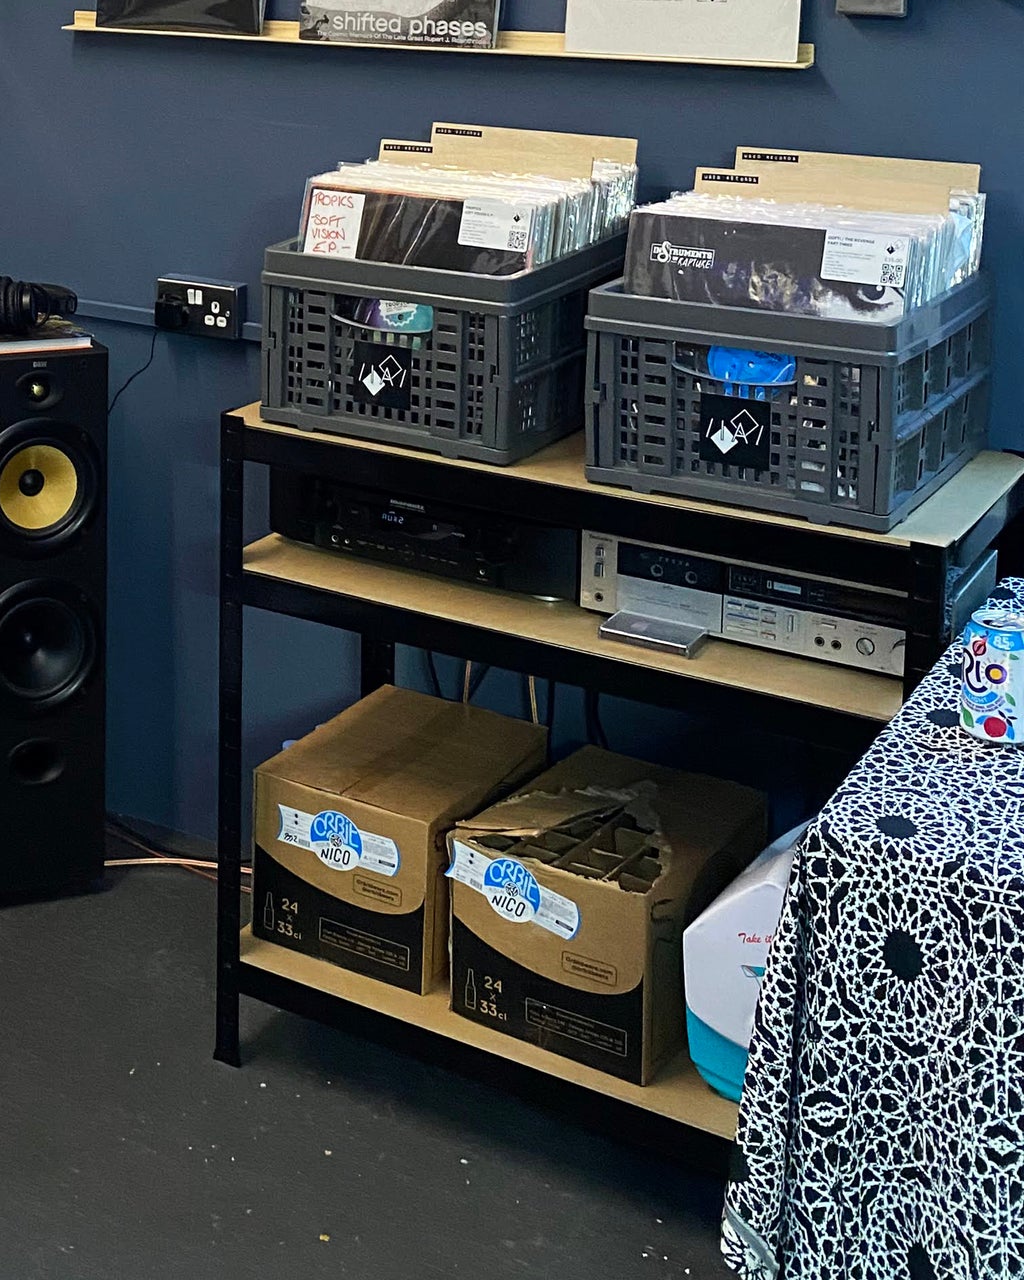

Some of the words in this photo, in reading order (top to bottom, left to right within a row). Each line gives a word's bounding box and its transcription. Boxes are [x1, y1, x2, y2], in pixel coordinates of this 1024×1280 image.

[332, 12, 402, 34] shifted
[408, 15, 488, 38] phases
[312, 191, 354, 209] TROPICS
[312, 228, 346, 241] VISION
[320, 847, 351, 866] NICO
[281, 898, 299, 914] 24
[491, 895, 526, 917] NICO
[277, 920, 303, 940] 33cl
[738, 932, 762, 944] Take
[484, 975, 503, 994] 24
[479, 999, 507, 1021] 33cl
